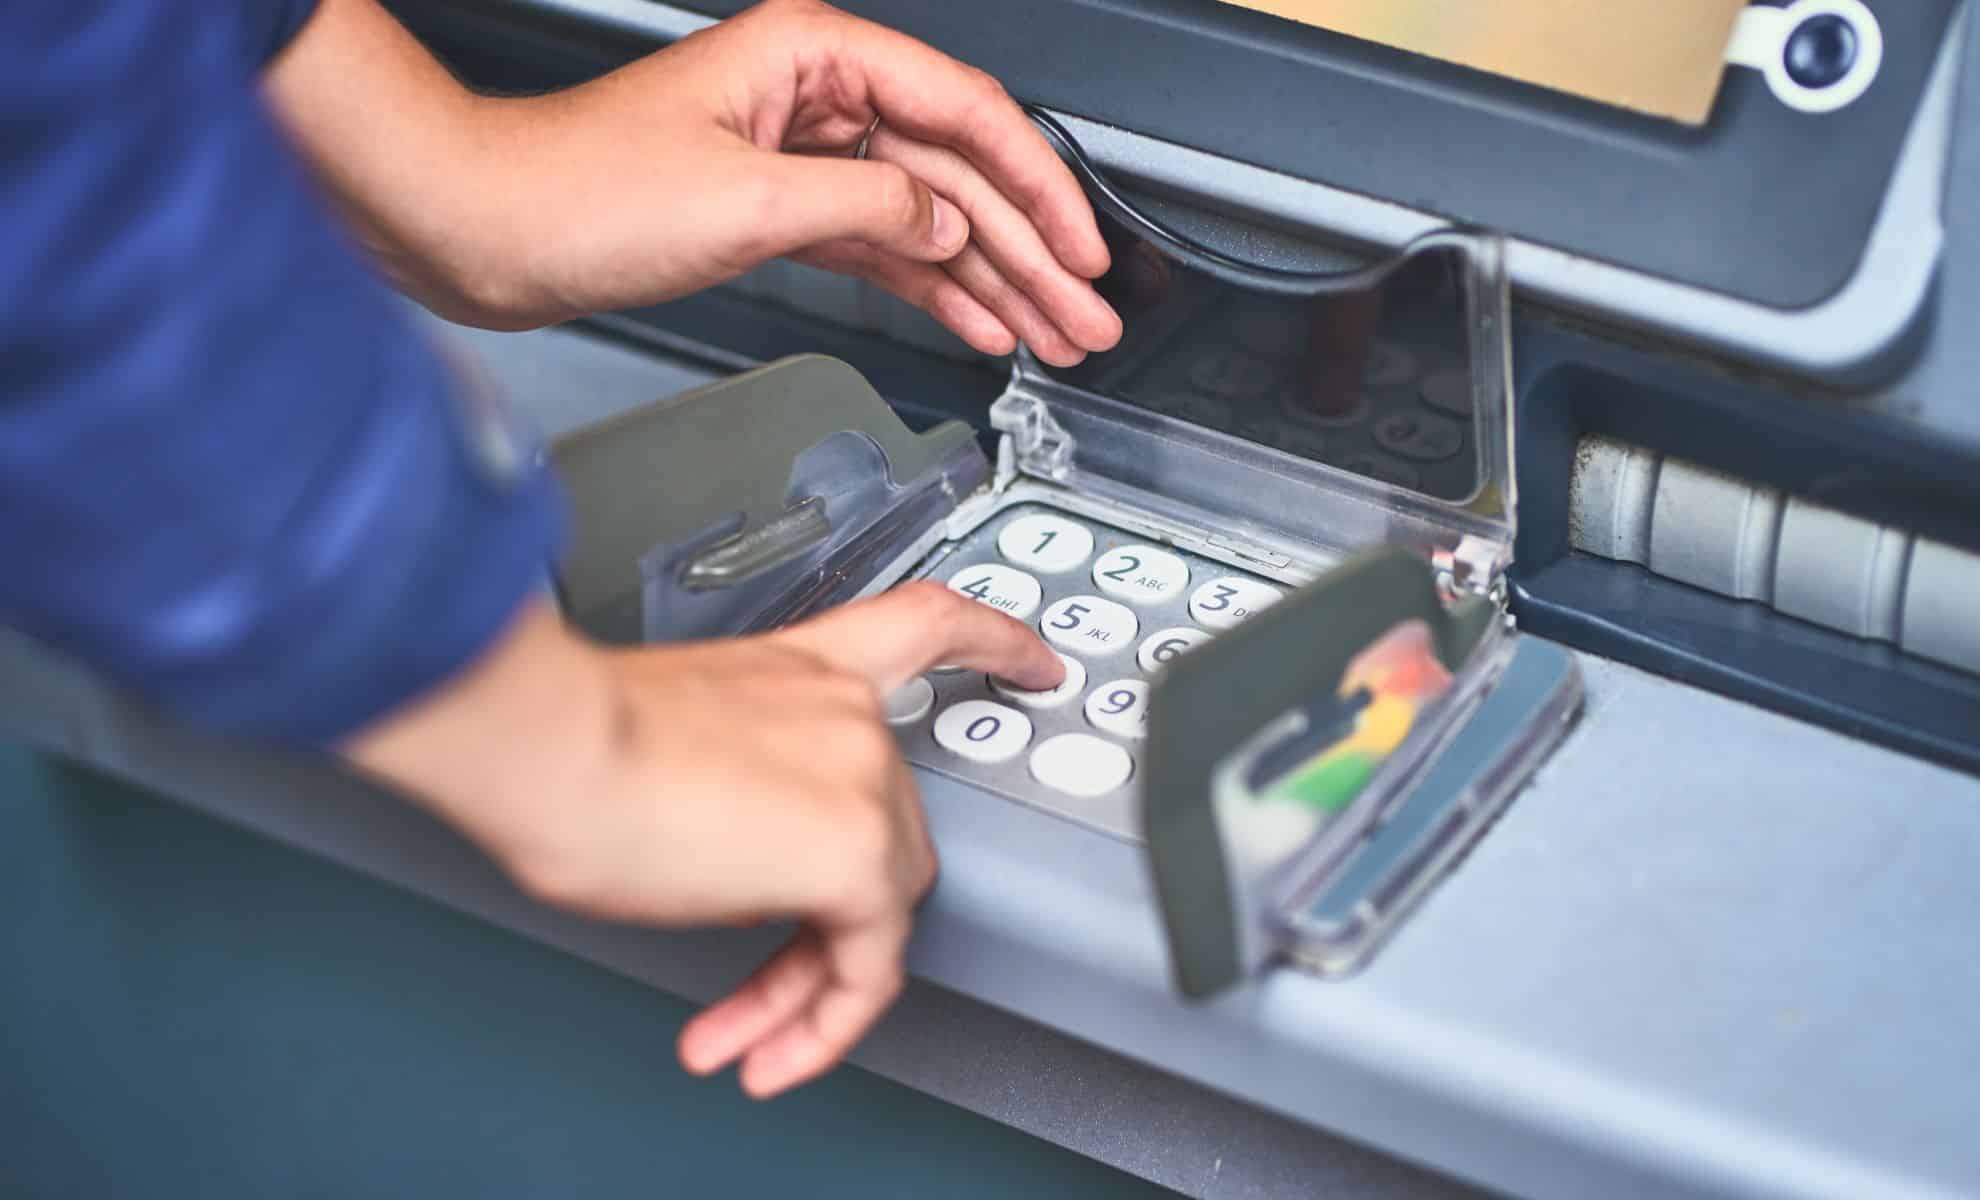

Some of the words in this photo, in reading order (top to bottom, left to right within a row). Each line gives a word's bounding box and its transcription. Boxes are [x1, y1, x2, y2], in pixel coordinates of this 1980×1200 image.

[1032, 531, 1058, 554] 1
[1102, 555, 1140, 582] 2
[1135, 577, 1169, 592] ABC
[960, 576, 992, 601] 4
[990, 596, 1019, 611] GHI
[1199, 584, 1239, 611] 3
[1050, 603, 1091, 630] 5
[1084, 628, 1113, 642] JKL
[1152, 638, 1190, 663] 6
[1098, 689, 1137, 714] 9
[966, 716, 1001, 742] 0
